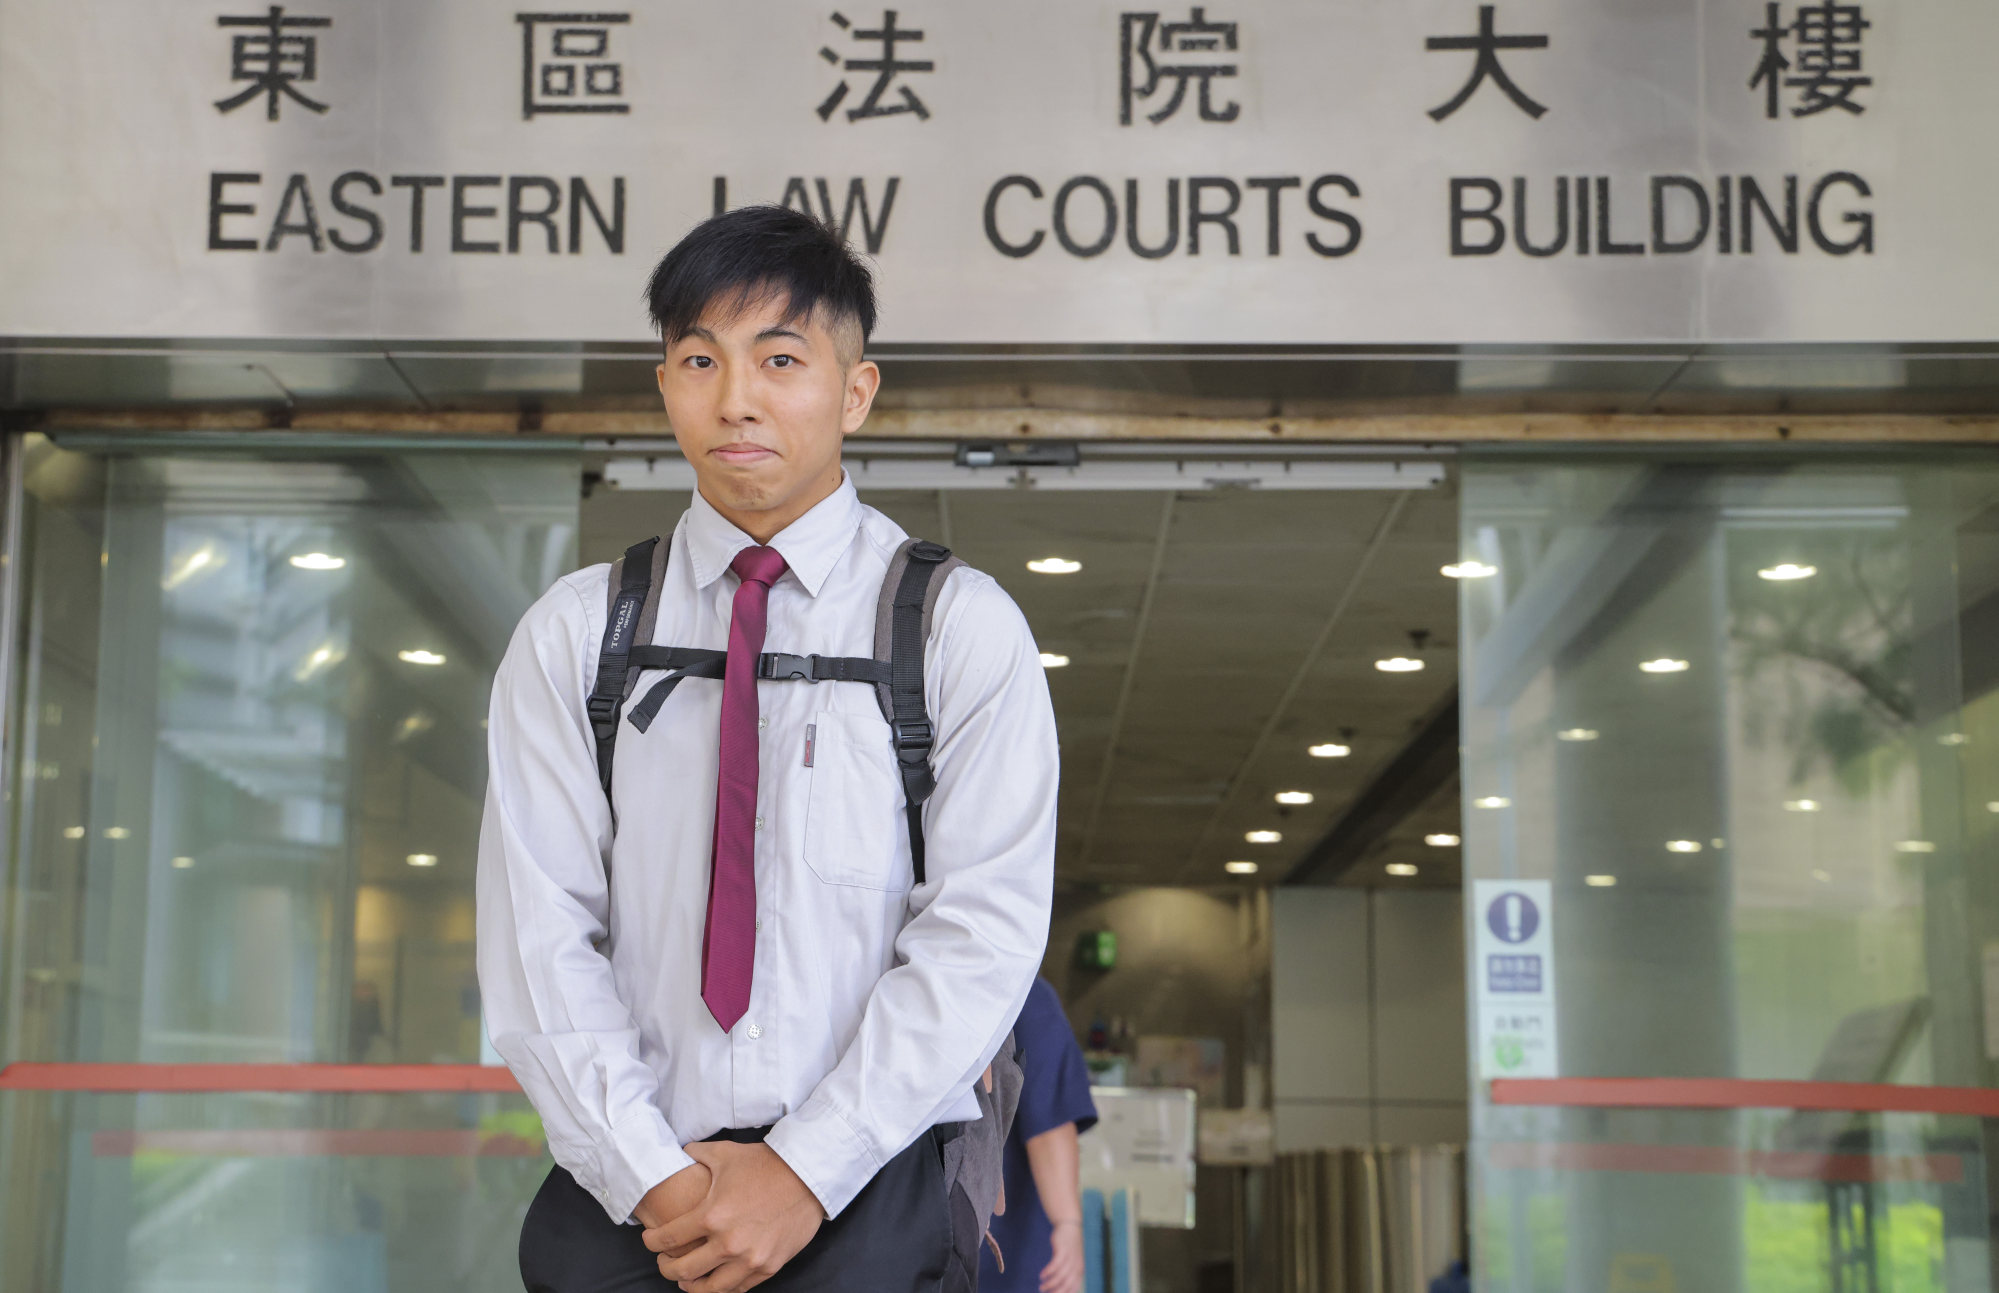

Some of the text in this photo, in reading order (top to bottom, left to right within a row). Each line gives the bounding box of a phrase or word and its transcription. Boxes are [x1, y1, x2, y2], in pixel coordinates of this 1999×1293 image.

[213, 2, 1872, 125] 東區法院大樓
[207, 172, 626, 255] EASTERN
[983, 173, 1363, 258] COURTS
[1449, 172, 1874, 257] BUILDING
[611, 601, 629, 648] TOPGAL
